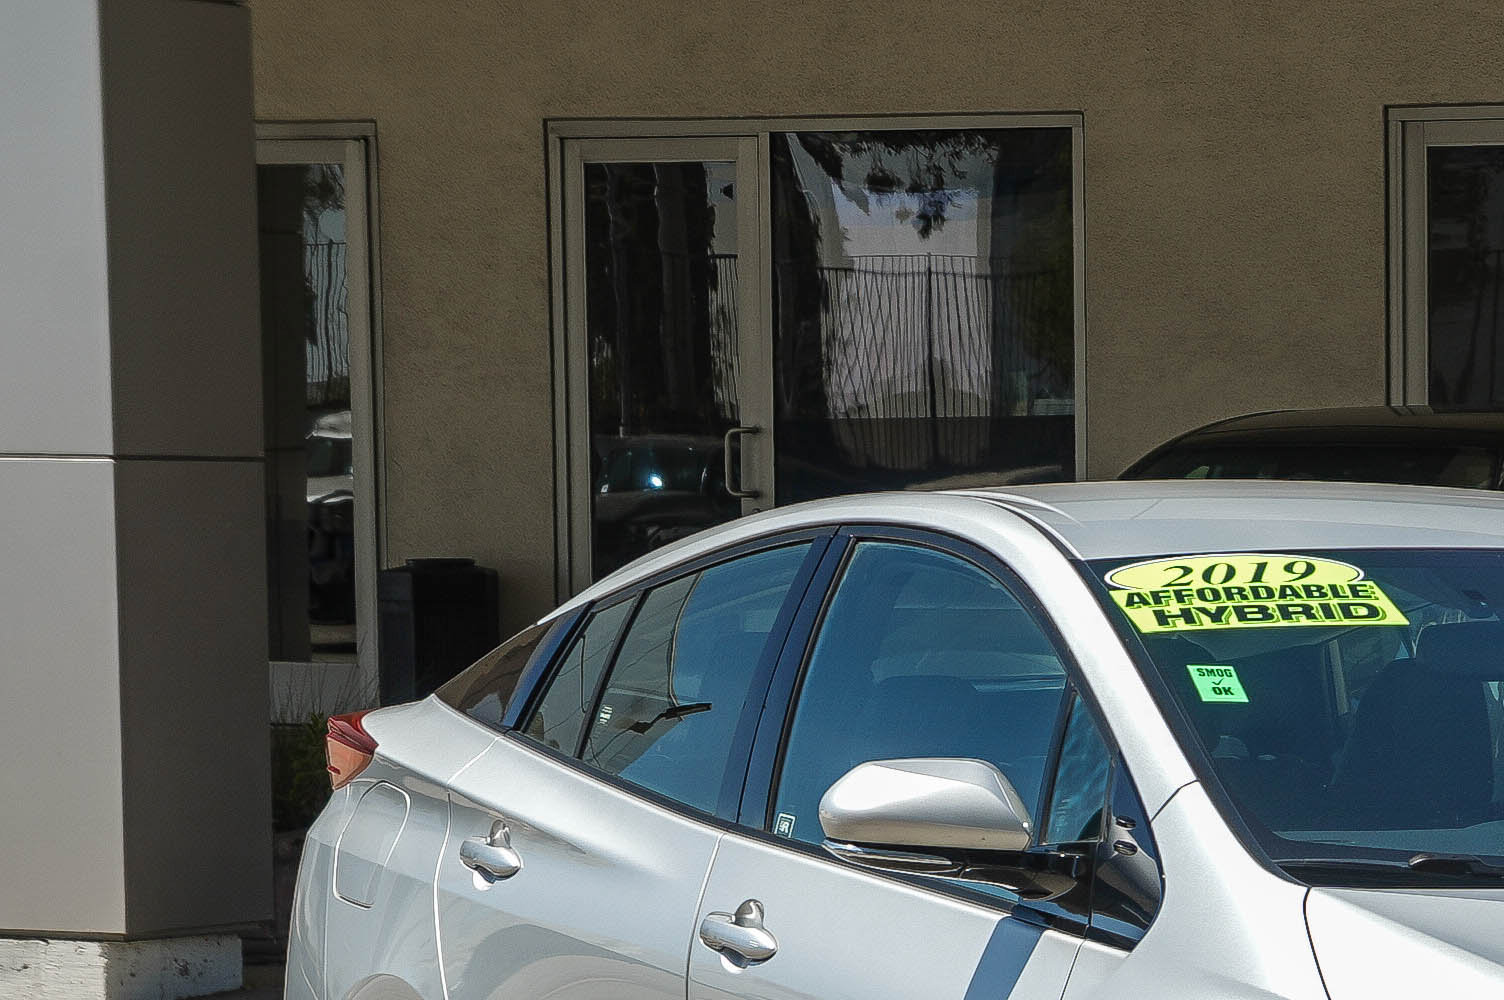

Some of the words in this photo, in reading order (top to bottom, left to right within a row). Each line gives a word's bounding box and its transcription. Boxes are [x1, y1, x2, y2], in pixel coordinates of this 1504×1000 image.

[1162, 560, 1316, 588] 2019
[1124, 583, 1376, 609] AFFORDABLE
[1152, 601, 1387, 628] HYBRID
[1196, 667, 1234, 679] SMOG
[1211, 686, 1236, 696] OK
